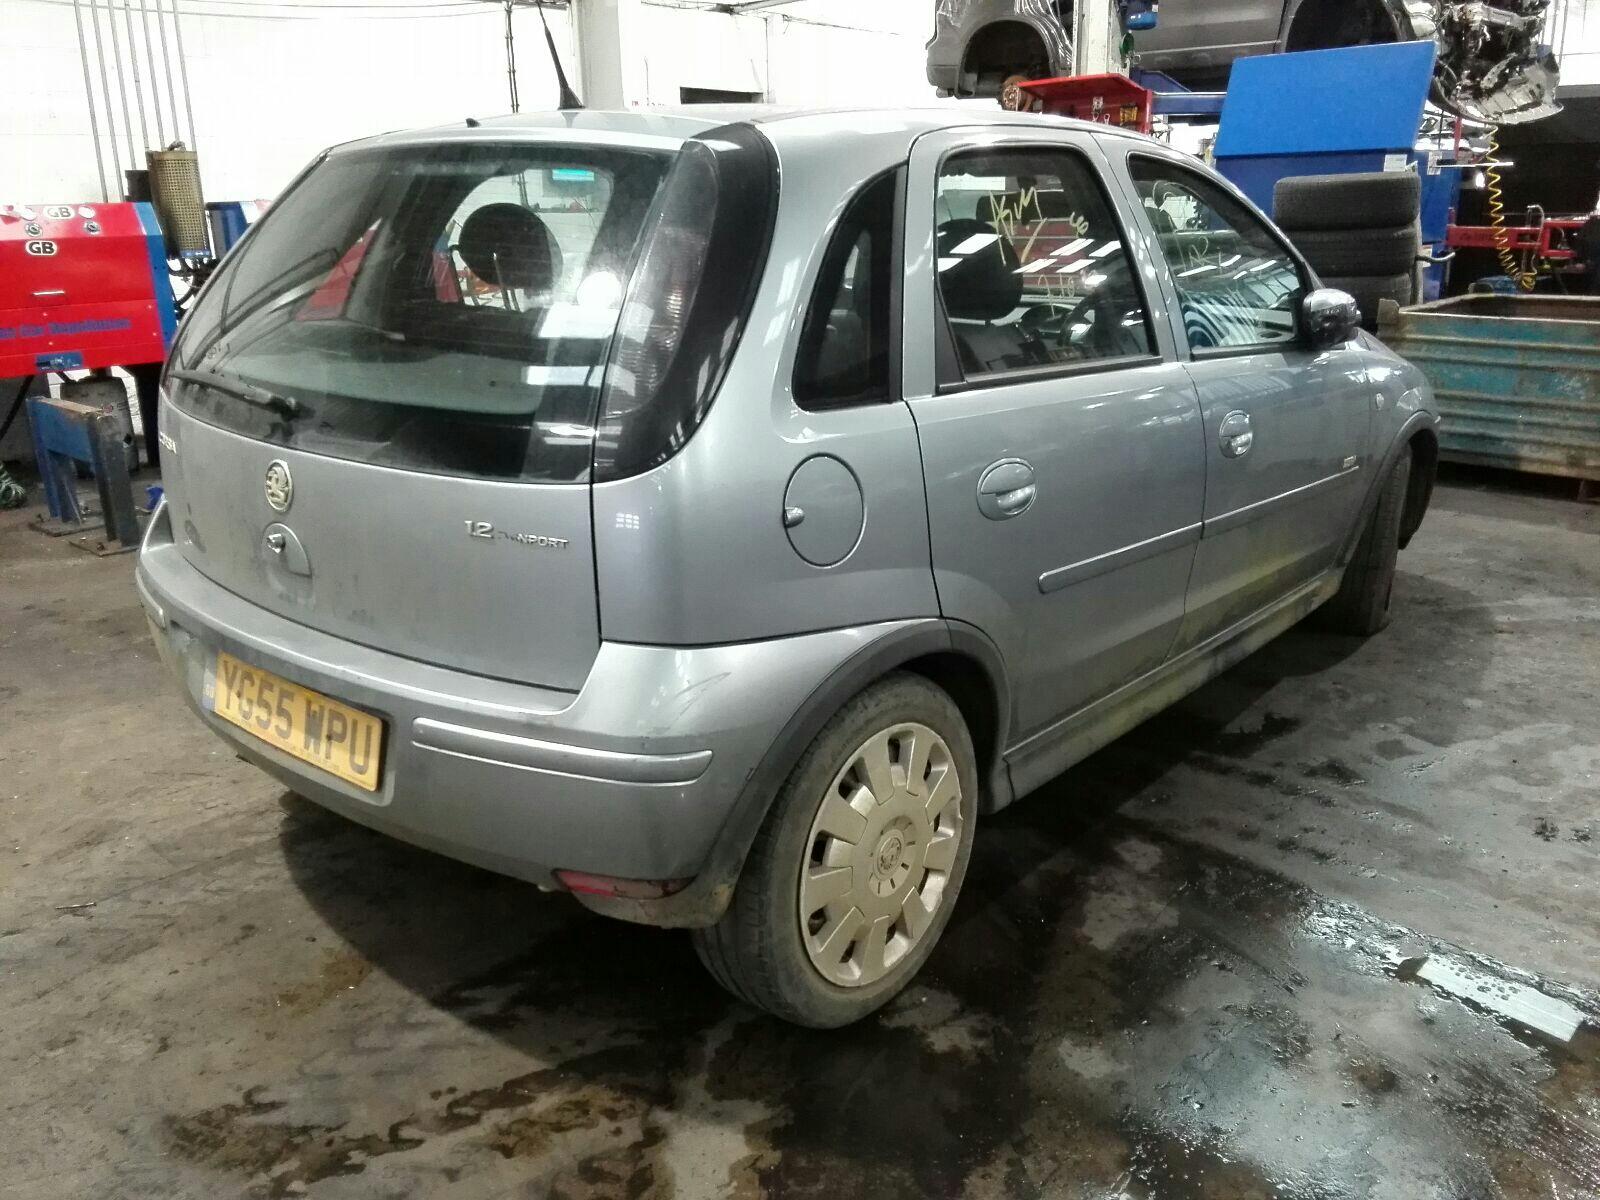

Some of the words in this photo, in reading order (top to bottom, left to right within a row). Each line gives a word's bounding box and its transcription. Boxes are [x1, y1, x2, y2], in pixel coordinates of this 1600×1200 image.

[47, 207, 71, 218] GB
[28, 241, 55, 254] GB
[222, 659, 295, 740] YG55
[303, 699, 372, 775] WPU
